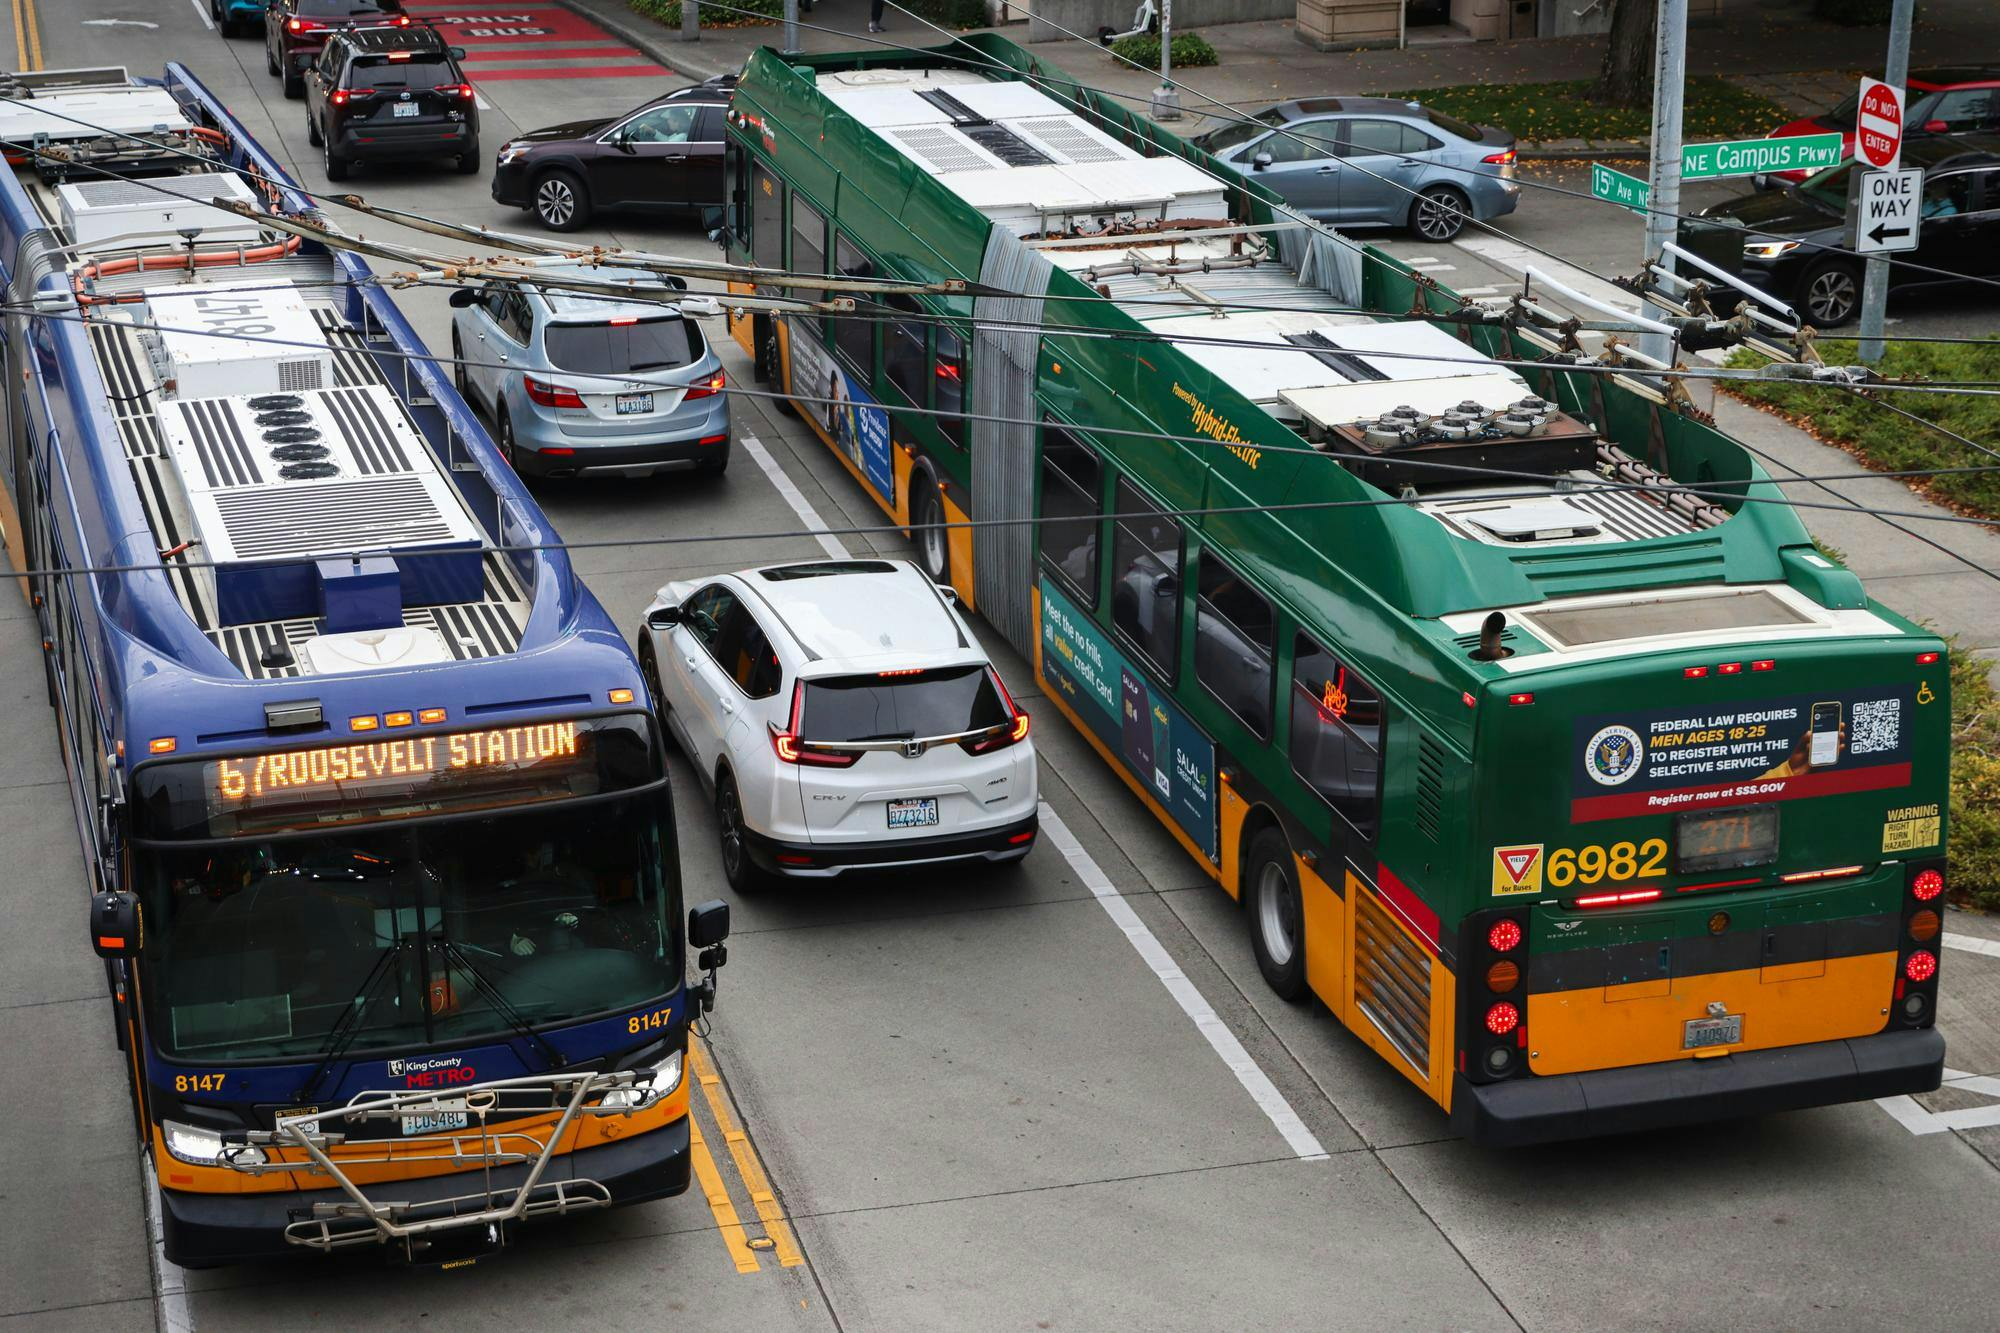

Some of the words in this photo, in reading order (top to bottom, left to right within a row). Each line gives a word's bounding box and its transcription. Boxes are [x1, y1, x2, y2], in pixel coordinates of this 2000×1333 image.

[445, 15, 531, 24] ONLY
[470, 28, 545, 36] BUS
[1865, 96, 1877, 112] DO
[1880, 103, 1897, 118] NOT
[1865, 134, 1891, 153] ENTER
[1686, 155, 1707, 172] NE
[1716, 145, 1791, 170] Campus
[1799, 147, 1836, 165] Pkwy
[1594, 168, 1615, 195] 15th
[1617, 186, 1632, 201] Ave
[1638, 193, 1650, 207] NE
[1873, 177, 1911, 196] ONE
[1870, 199, 1911, 218] WAY
[194, 297, 276, 336] 8147
[1172, 382, 1193, 404] Powered
[1192, 402, 1261, 469] Hybrid-Electric
[1045, 596, 1062, 626] Meet
[1062, 615, 1075, 638] the
[1075, 631, 1085, 650] no
[1086, 638, 1104, 672] frills,
[1045, 624, 1054, 642] all
[1054, 634, 1074, 662] value
[1074, 655, 1096, 686] credit
[1096, 676, 1114, 706] card.
[1650, 717, 1705, 733] FEDERAL
[1708, 714, 1736, 728] LAW
[1737, 708, 1798, 724] REQUIRES
[1650, 734, 1684, 748] MEN
[1686, 729, 1725, 745] AGES
[1728, 725, 1767, 740] 18-25
[269, 738, 435, 788] ROOSEVELT
[450, 722, 575, 768] STATION
[1650, 752, 1667, 763] TO
[1669, 746, 1729, 762] REGISTER
[1730, 742, 1763, 755] WITH
[1765, 739, 1789, 750] THE
[1177, 748, 1201, 784] SALAL
[1649, 762, 1714, 778] SELECTIVE
[1716, 756, 1770, 771] SERVICE.
[1648, 794, 1694, 807] Register
[1696, 791, 1719, 801] now
[1721, 787, 1733, 797] at
[1735, 782, 1785, 796] SSS.GOV
[1887, 804, 1938, 821] WARNING
[1698, 816, 1751, 854] 271
[1888, 822, 1910, 832] RIGHT
[1889, 831, 1908, 841] TURN
[1884, 840, 1911, 850] HAZARD
[1547, 838, 1668, 887] 6982
[1513, 884, 1532, 892] Buses
[628, 1008, 671, 1034] 8147
[406, 1061, 428, 1071] King
[428, 1057, 462, 1068] County
[175, 1073, 225, 1092] 8147
[406, 1066, 476, 1089] METRO
